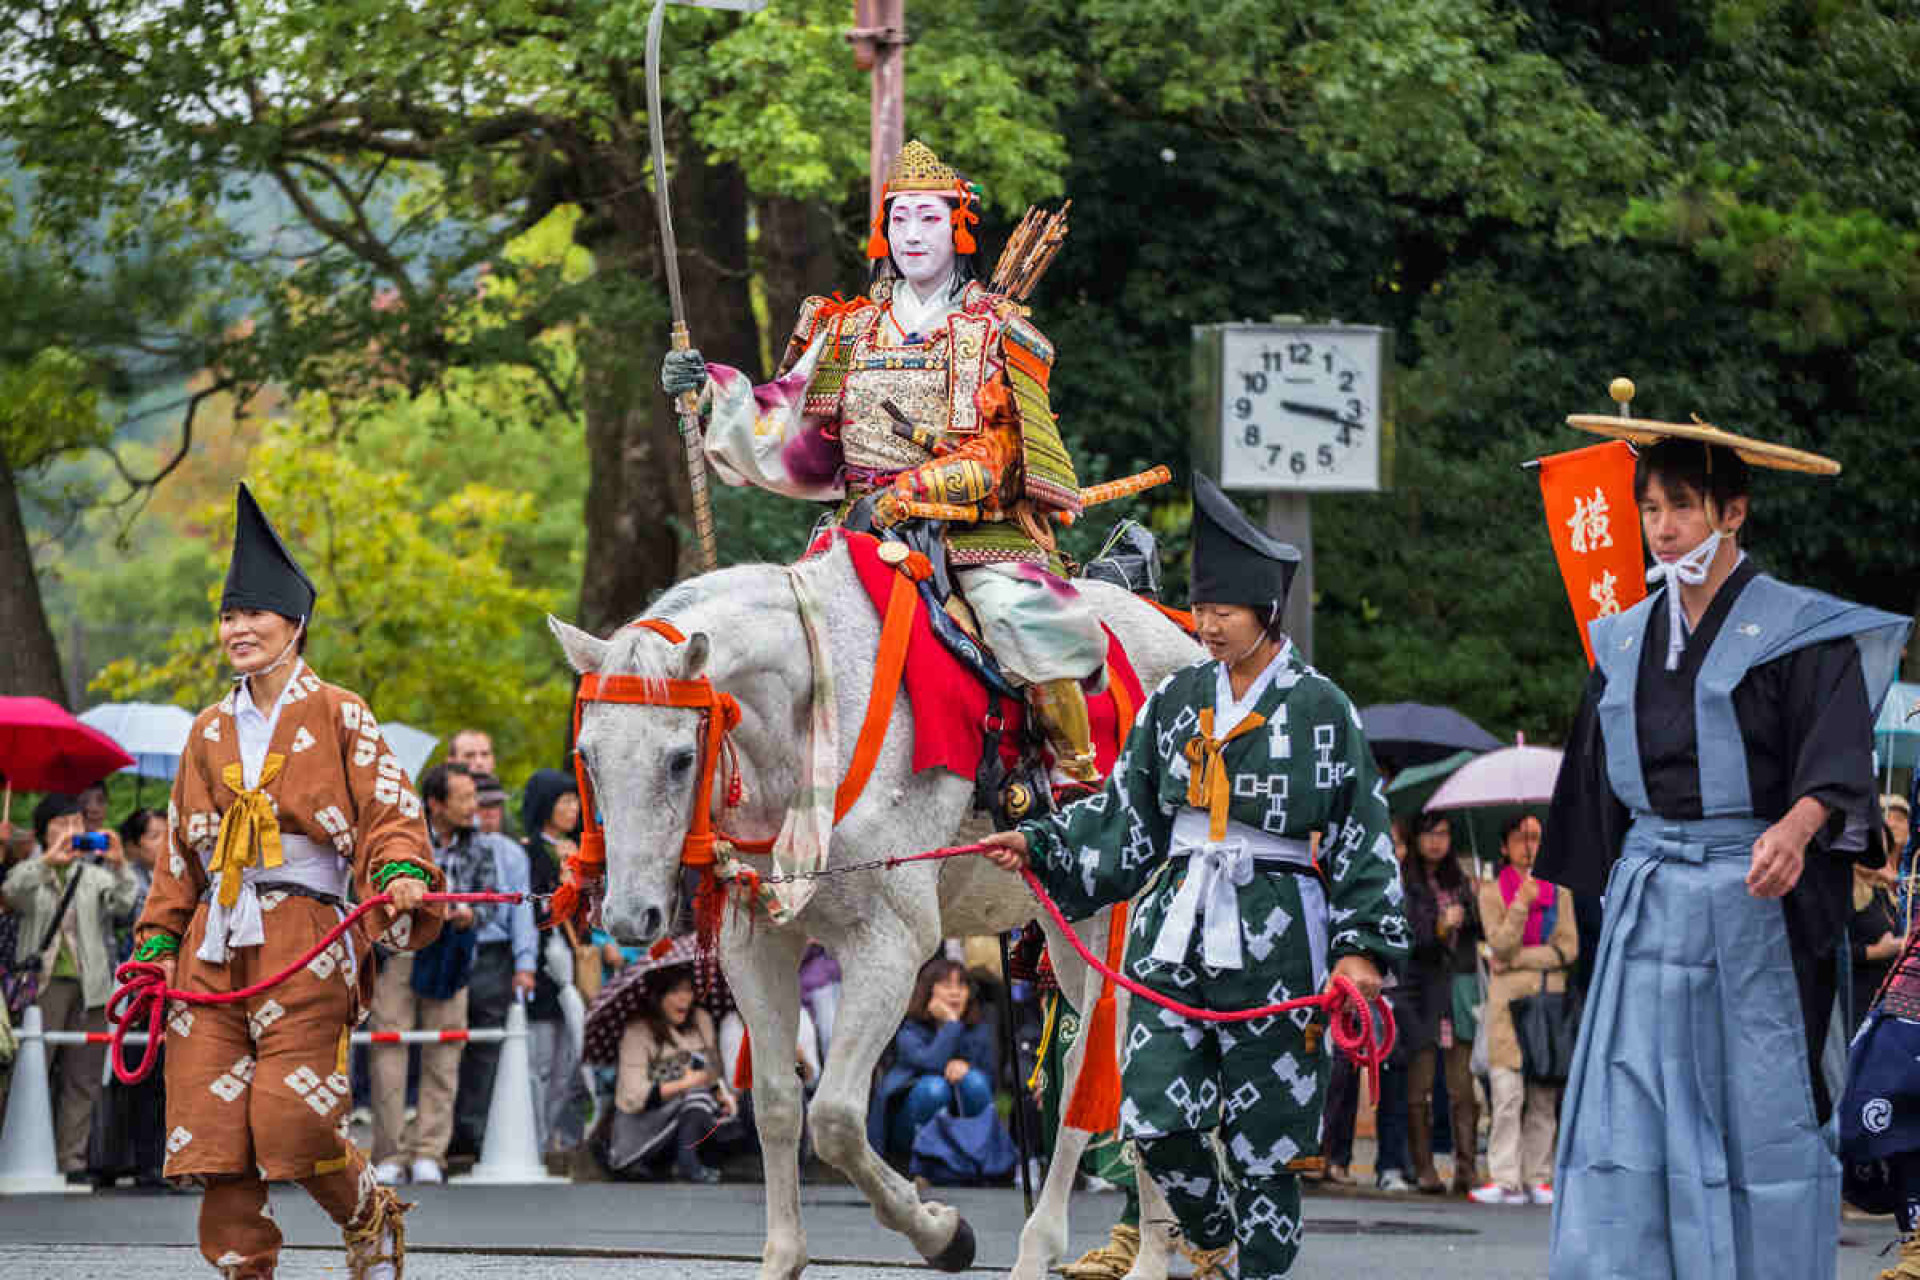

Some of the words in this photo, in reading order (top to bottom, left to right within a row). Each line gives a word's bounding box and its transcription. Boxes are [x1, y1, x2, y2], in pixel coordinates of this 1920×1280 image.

[1261, 352, 1282, 371] 11
[1289, 343, 1312, 364] 12
[1323, 352, 1332, 373] 1
[1242, 371, 1267, 394] 10
[1339, 370, 1354, 392] 2
[1235, 397, 1252, 419] 9
[1346, 398, 1361, 420] 3
[1244, 424, 1260, 446] 8
[1335, 421, 1351, 447] 4
[1266, 444, 1281, 465] 7
[1290, 451, 1305, 474] 6
[1318, 445, 1333, 467] 5
